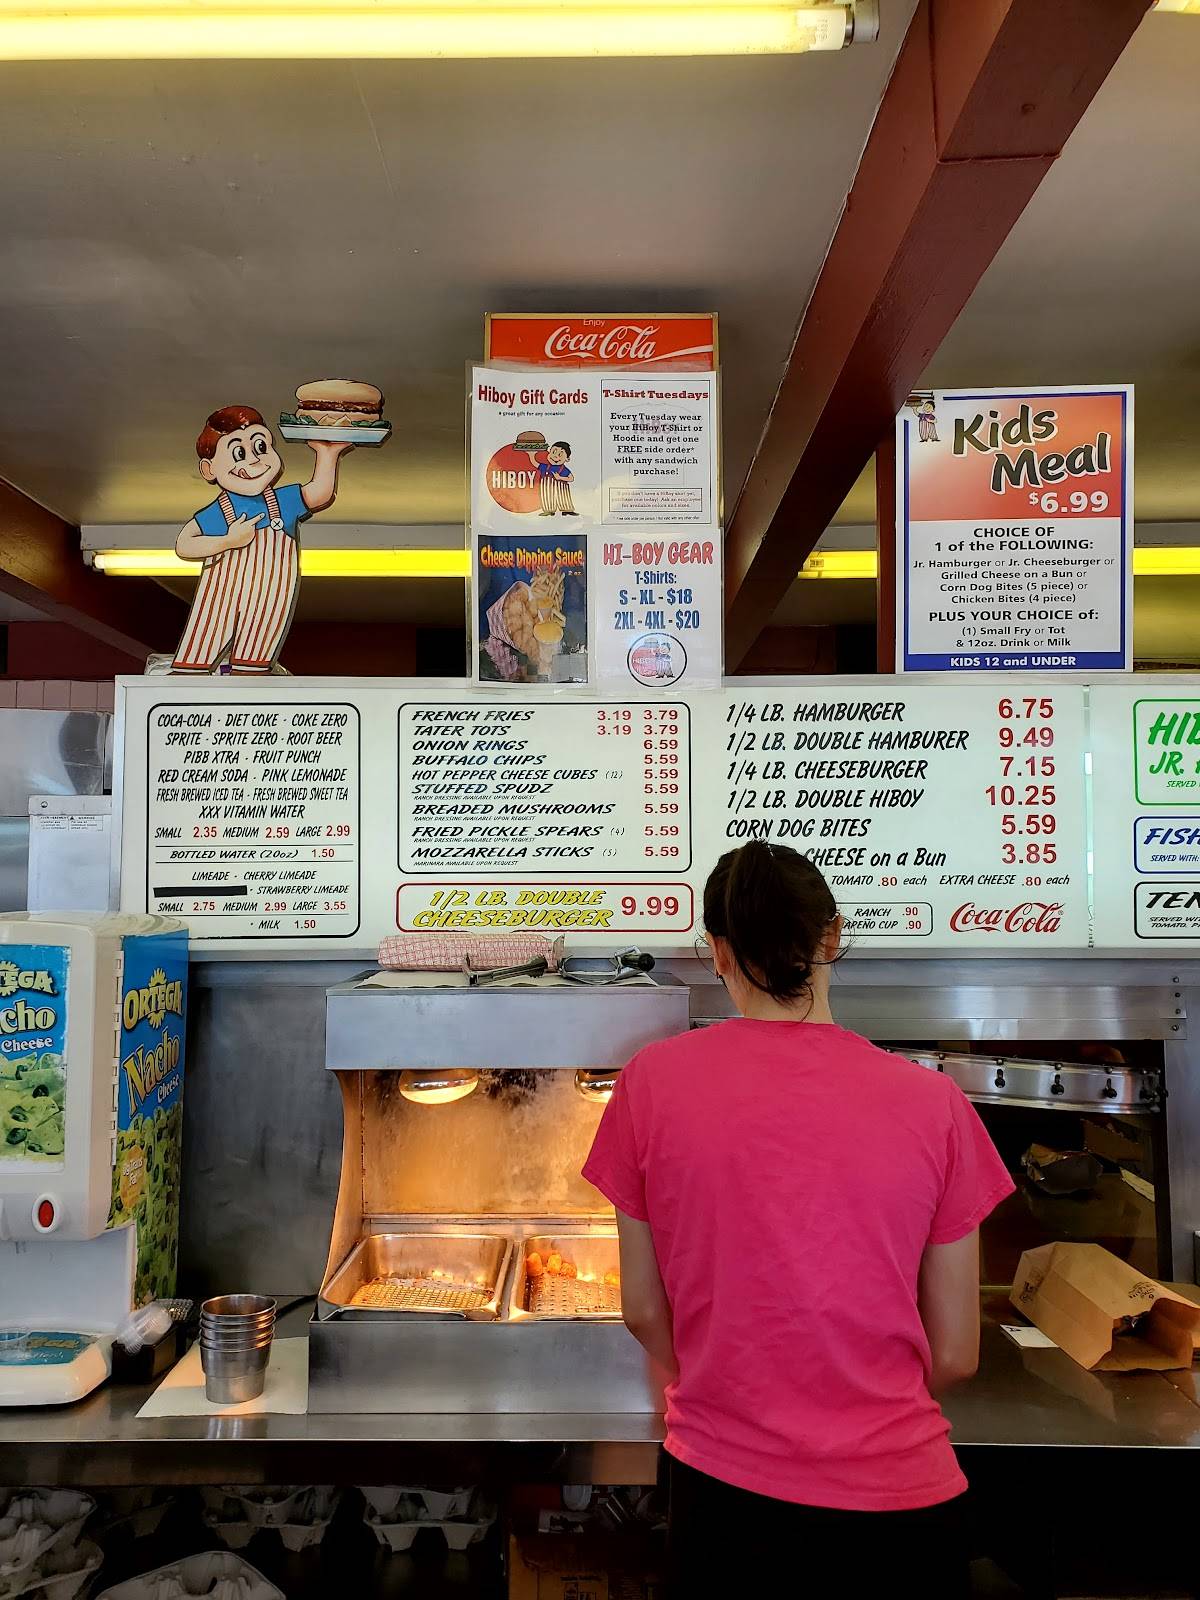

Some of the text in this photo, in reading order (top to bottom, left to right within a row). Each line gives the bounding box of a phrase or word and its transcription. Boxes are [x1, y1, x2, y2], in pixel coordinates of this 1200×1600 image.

[545, 326, 660, 359] Coca-Cola
[479, 384, 588, 408] Hiboy Gift Cards
[603, 390, 708, 400] T-Shirt Tuesdays
[611, 413, 637, 421] Every
[639, 413, 676, 421] Tuesday
[952, 404, 1058, 457] Kids
[990, 432, 1112, 494] Meal
[633, 467, 679, 476] purchase!
[492, 470, 536, 489] HIBOY
[1029, 491, 1109, 512] $6.99
[935, 540, 1094, 551] 1 of the FOLLOWING:
[481, 546, 583, 573] Cheese Dipping Sauce
[603, 542, 713, 566] HI-BOY GEAR
[635, 571, 677, 584] T-Shirts:
[952, 594, 1076, 603] Chicken Bites (4 piece)
[929, 610, 1098, 621] PLUS YOUR CHOICE of:
[957, 639, 963, 647] &
[968, 639, 996, 648] 12oz.
[1001, 639, 1030, 647] Drink
[1048, 638, 1071, 646] Milk
[950, 656, 1076, 666] KIDS 12 and UNDER
[412, 710, 678, 721] FRENCH FRIES 3.19 3.79
[726, 698, 1054, 727] 1/4 LB. HAMBURGER 6.75
[158, 713, 348, 728] COCA-COLA DIET COKE COKE ZERO
[165, 732, 342, 745] SPRITE SPRITE ZERO ROOT BEER
[412, 739, 678, 750] ONION RINGS 6.59
[184, 751, 321, 764] PIBB XTRA FRUIT PUNCH
[1149, 751, 1184, 776] JR.
[412, 770, 438, 780] HOT
[442, 770, 497, 780] PEPPER
[500, 770, 549, 780] CHEESE
[553, 770, 598, 780] CUBES
[644, 768, 679, 780] 5.59
[726, 785, 1056, 813] 1/2 LB. DOUBLE HIBOY 10.25
[198, 805, 305, 818] XXX VITAMIN WATER
[155, 825, 350, 838] SMALL 2.35 MEDIUM 2.59 LARGE 2.99
[412, 826, 464, 837] FRIED
[468, 826, 528, 836] PICKLE
[534, 826, 604, 836] SPEARS
[644, 826, 679, 836] 5.59
[726, 814, 1056, 838] CORN DOG BITES 5.59
[170, 850, 216, 859] BOTTLED
[219, 850, 256, 859] WATER
[312, 849, 335, 858] 1.50
[410, 847, 528, 858] MOZZARELLA
[532, 846, 594, 857] STICKS
[644, 846, 679, 857] 5.59
[870, 852, 893, 867] on
[896, 852, 910, 866] a
[913, 848, 946, 867] Bun
[1002, 843, 1056, 865] 3.85
[192, 871, 317, 880] LIMEADE CHERRY LIMEADE
[831, 874, 1070, 887] TOMATO .80 each EXTRA CHEESE .80 each
[430, 890, 606, 910] 1/2 LB. DOUBLE
[412, 896, 680, 927] CHEESEBURGER 9.99
[855, 907, 918, 917] RANCH .90
[949, 902, 1065, 934] Coca-Cola
[258, 919, 316, 929] MILK 1.50
[879, 921, 898, 929] CUP
[905, 921, 921, 929] .90
[123, 981, 183, 1030] ORTEGA
[1, 1037, 53, 1052] Cheese
[123, 1027, 180, 1118] Nacho
[157, 1074, 179, 1103] Cheese
